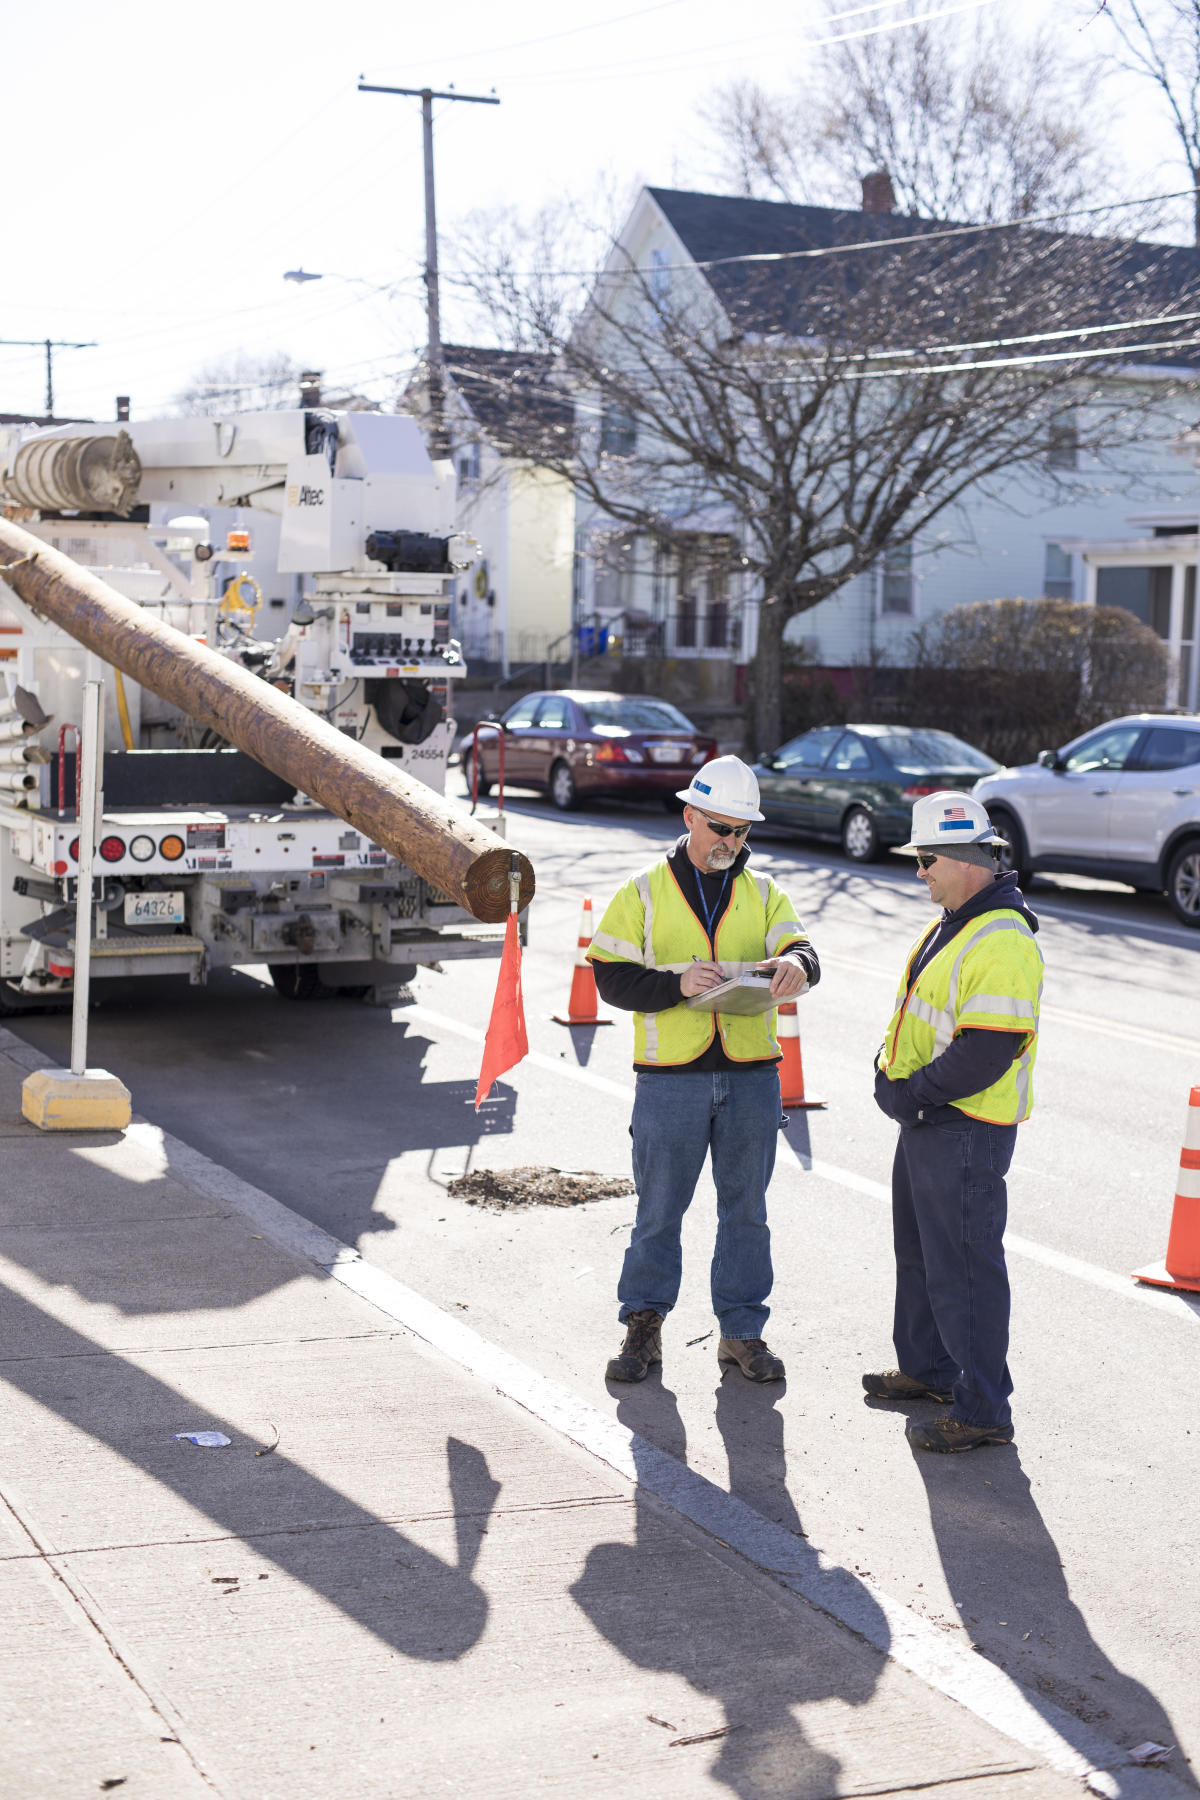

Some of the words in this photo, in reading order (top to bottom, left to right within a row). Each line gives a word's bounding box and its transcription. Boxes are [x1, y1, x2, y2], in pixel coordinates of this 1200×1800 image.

[299, 485, 324, 506] Altec
[411, 749, 444, 760] 24554
[135, 900, 174, 916] 64326
